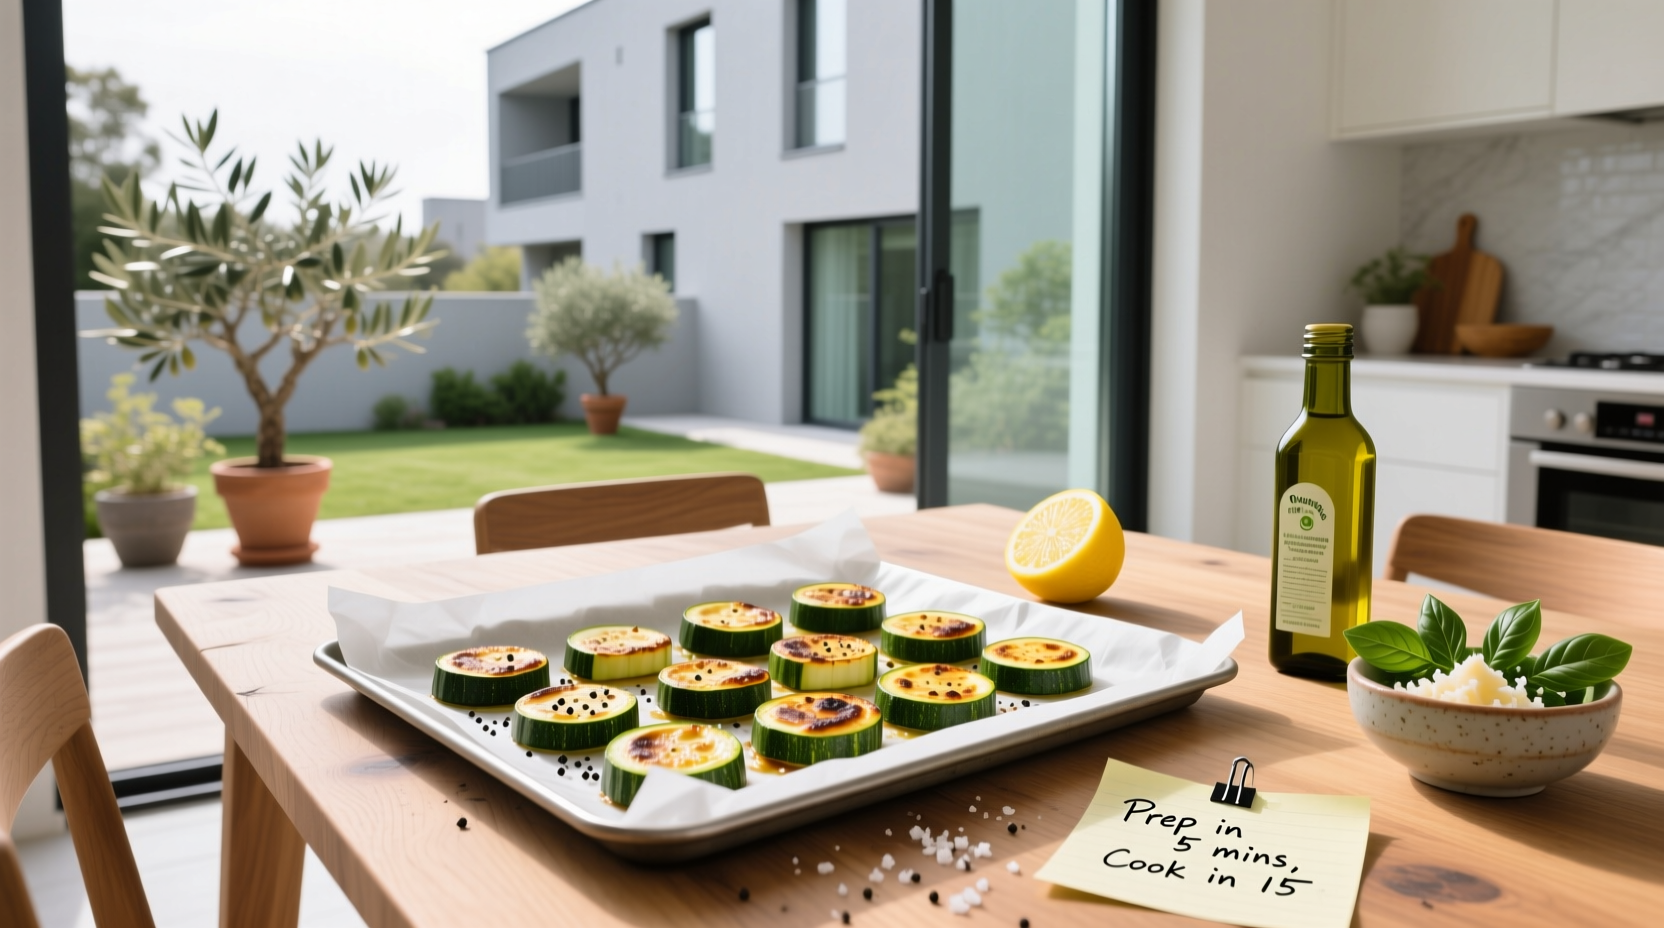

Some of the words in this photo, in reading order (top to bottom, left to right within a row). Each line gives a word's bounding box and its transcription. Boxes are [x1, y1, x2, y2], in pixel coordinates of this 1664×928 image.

[1124, 798, 1197, 836] Prep
[1215, 818, 1242, 839] in
[1103, 848, 1186, 879] Cook
[1207, 867, 1236, 888] in
[1261, 876, 1313, 897] 15
[1173, 835, 1202, 852] 5
[1212, 846, 1299, 874] mins,
